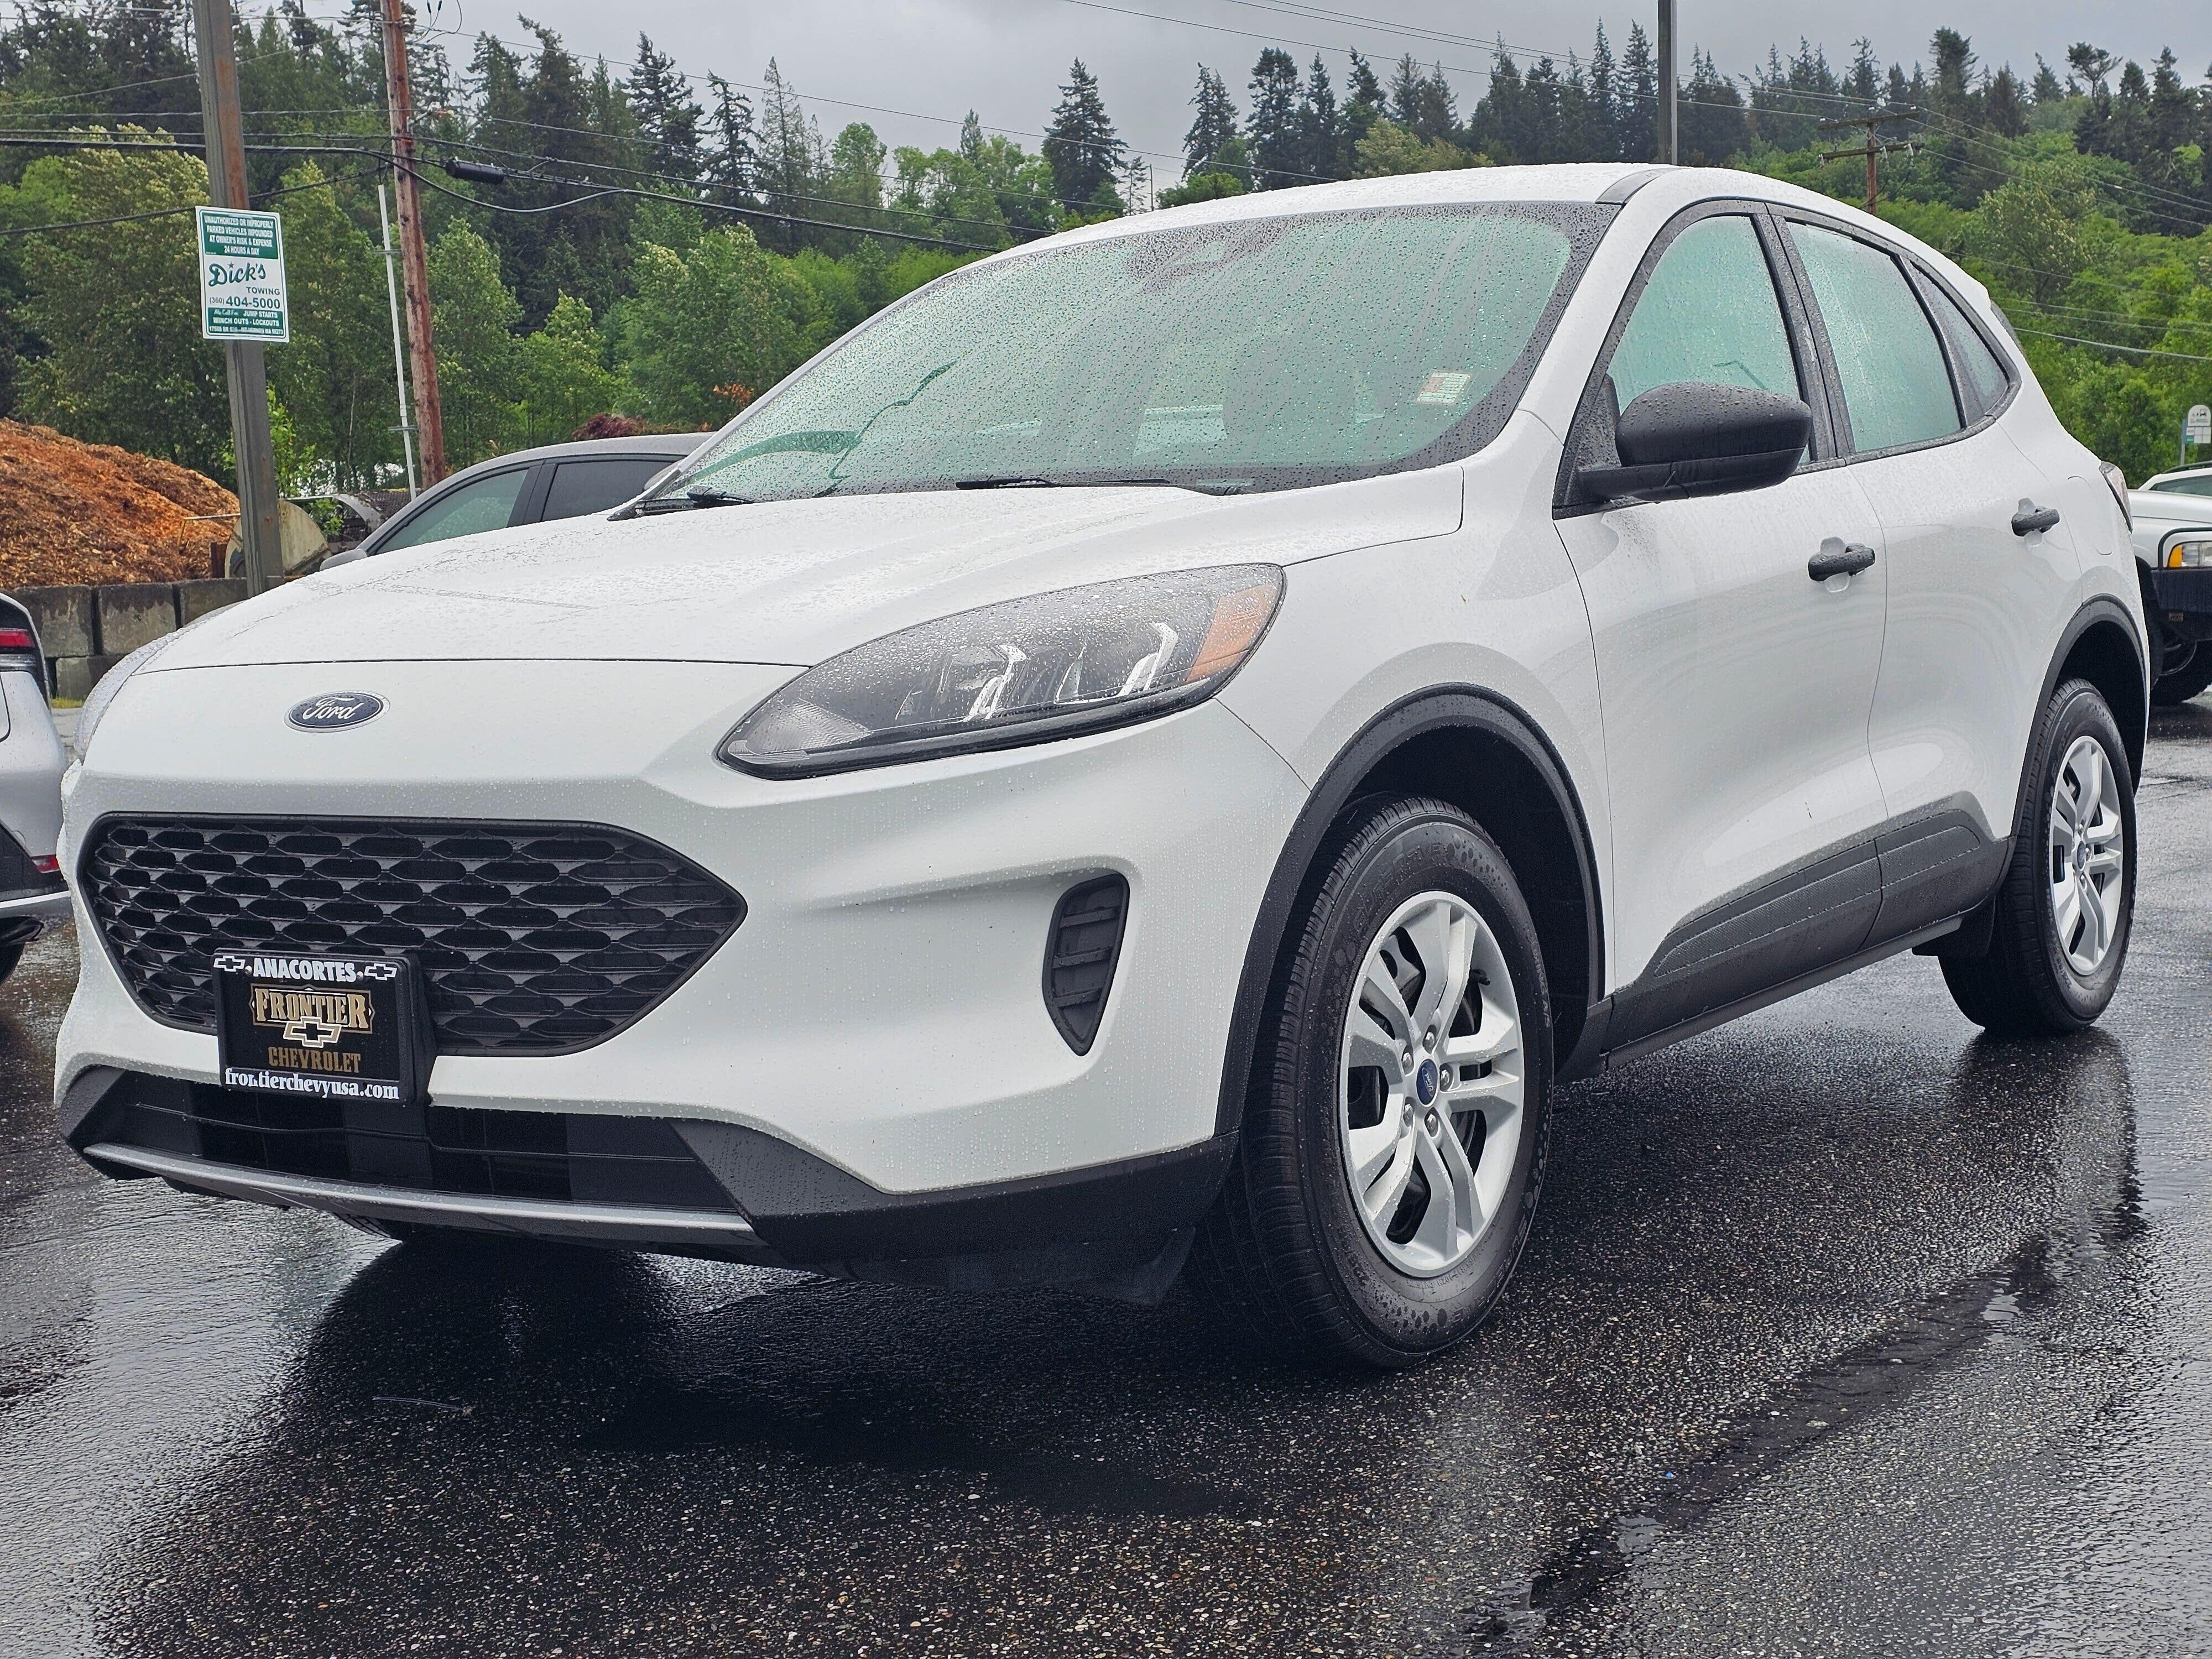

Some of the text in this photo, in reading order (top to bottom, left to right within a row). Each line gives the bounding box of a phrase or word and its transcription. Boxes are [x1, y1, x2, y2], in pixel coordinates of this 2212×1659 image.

[204, 215, 239, 226] UNAUTHORIZED
[247, 219, 274, 228] IMPROPERLY
[206, 225, 273, 238] PARKED VEHICLES IMPOUNDED
[253, 238, 273, 247] EXPENSE
[231, 246, 246, 254] HOURS
[208, 262, 265, 286] Dick's
[246, 286, 280, 295] TOWING
[226, 296, 280, 309] 404-5000
[302, 697, 365, 720] Ford
[253, 957, 357, 983] ANACORTES
[255, 988, 369, 1029] FRONTIER
[268, 1046, 361, 1073] CHEVROLET
